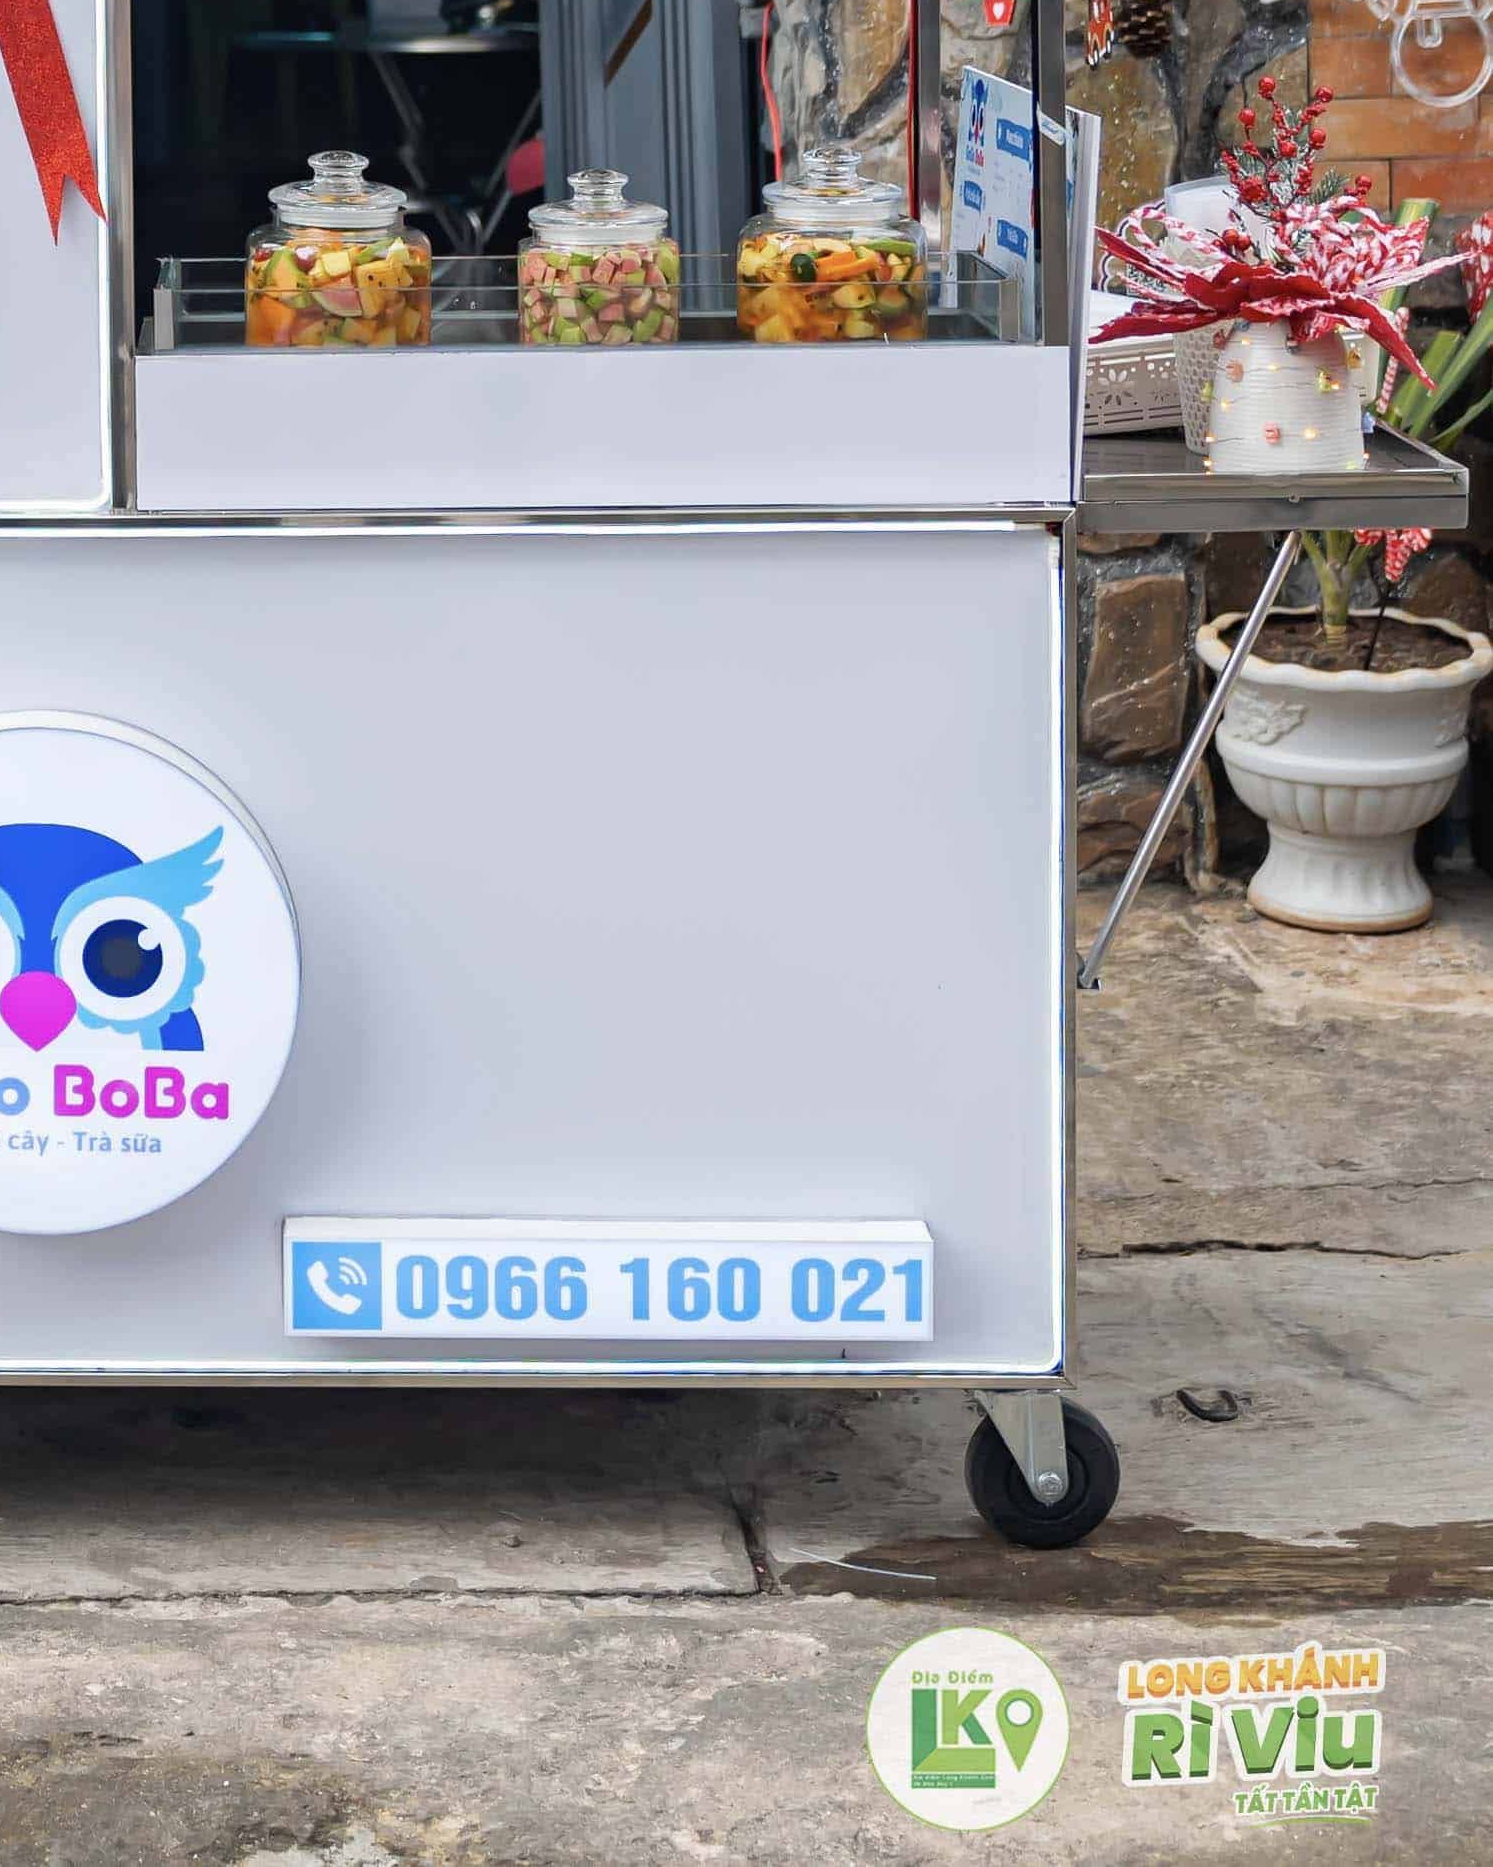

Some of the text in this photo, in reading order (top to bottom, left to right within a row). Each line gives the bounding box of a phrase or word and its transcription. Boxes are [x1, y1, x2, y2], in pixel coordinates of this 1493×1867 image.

[53, 1064, 229, 1120] BoBa
[8, 1127, 49, 1156] cây
[73, 1130, 112, 1152] Trà
[121, 1131, 162, 1153] sữa
[396, 1254, 923, 1323] 0966 160 021
